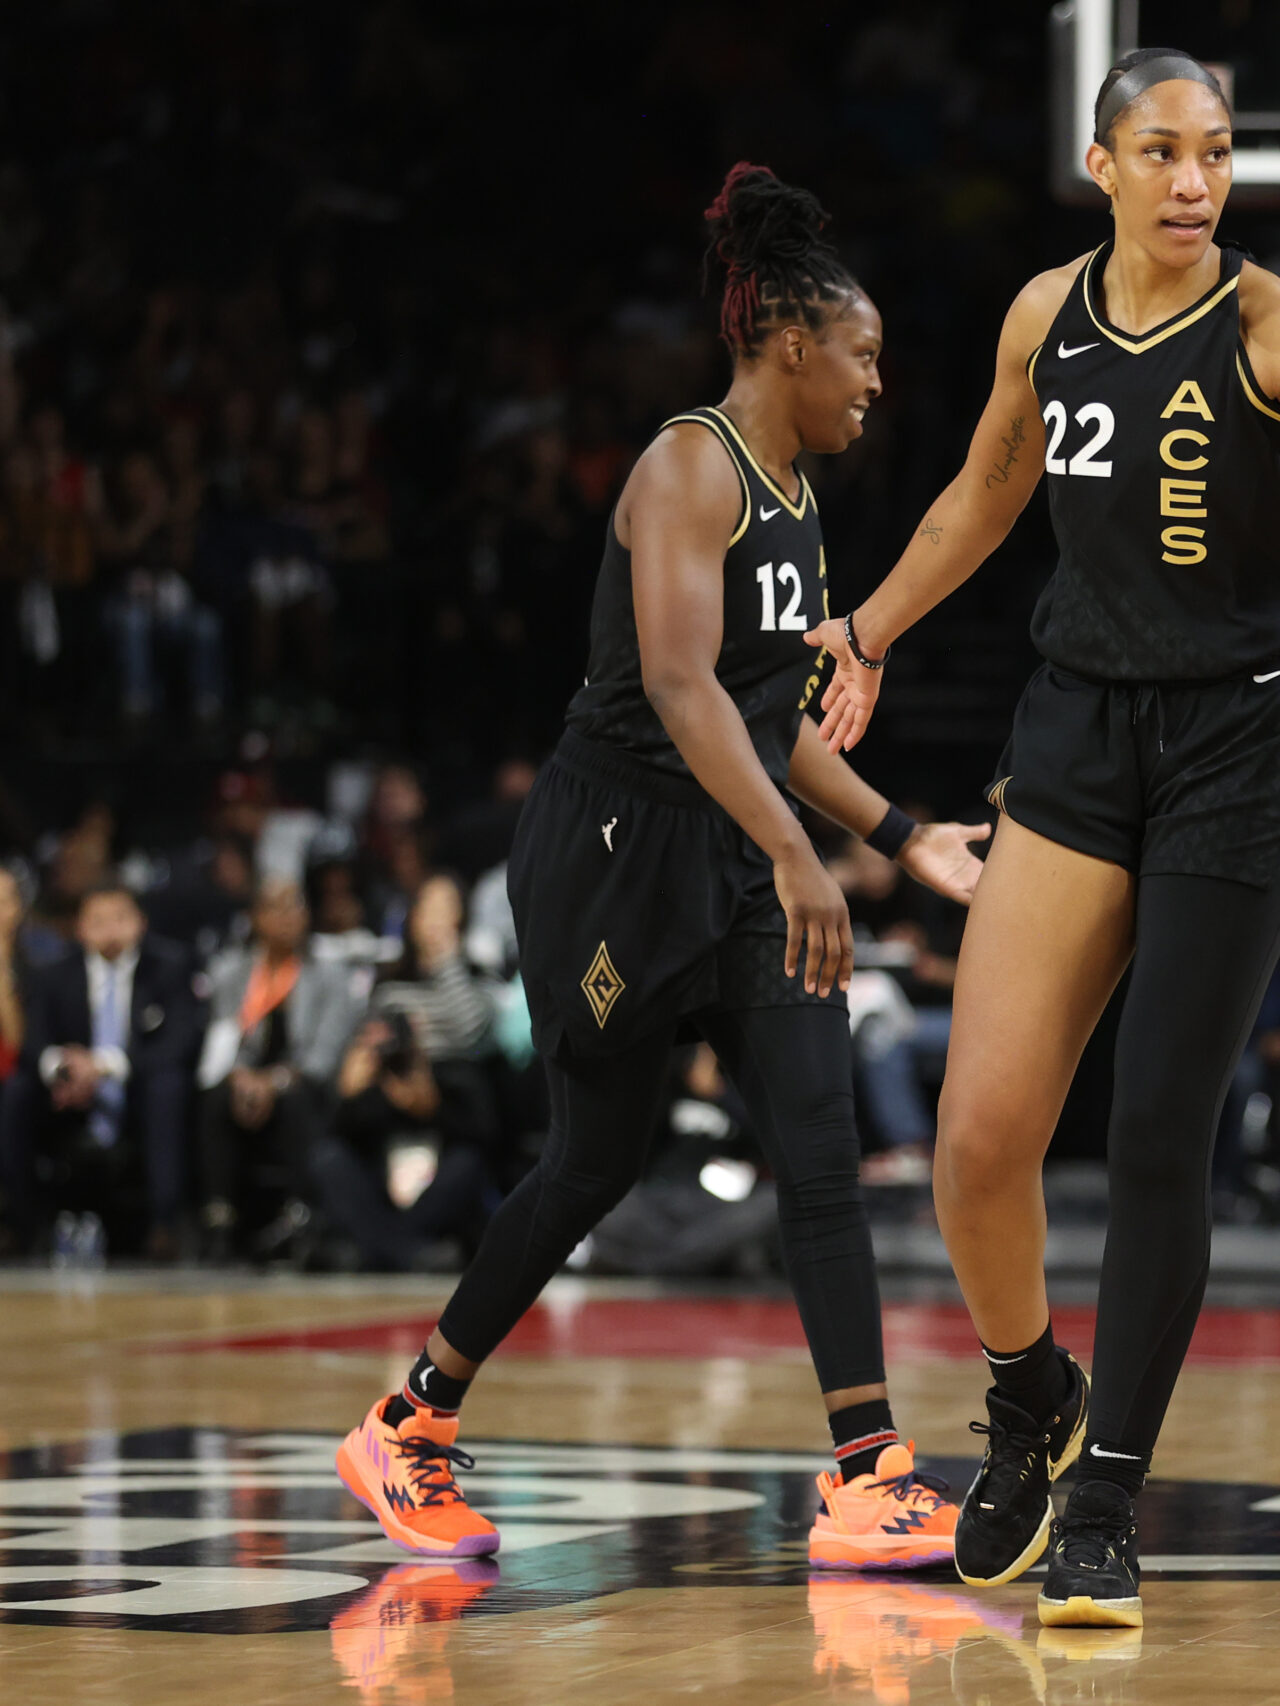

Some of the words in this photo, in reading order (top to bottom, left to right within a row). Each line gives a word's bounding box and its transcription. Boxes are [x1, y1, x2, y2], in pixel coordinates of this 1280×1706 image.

[1043, 400, 1115, 477] 22
[1159, 380, 1215, 565] ACES
[756, 561, 808, 631] 12
